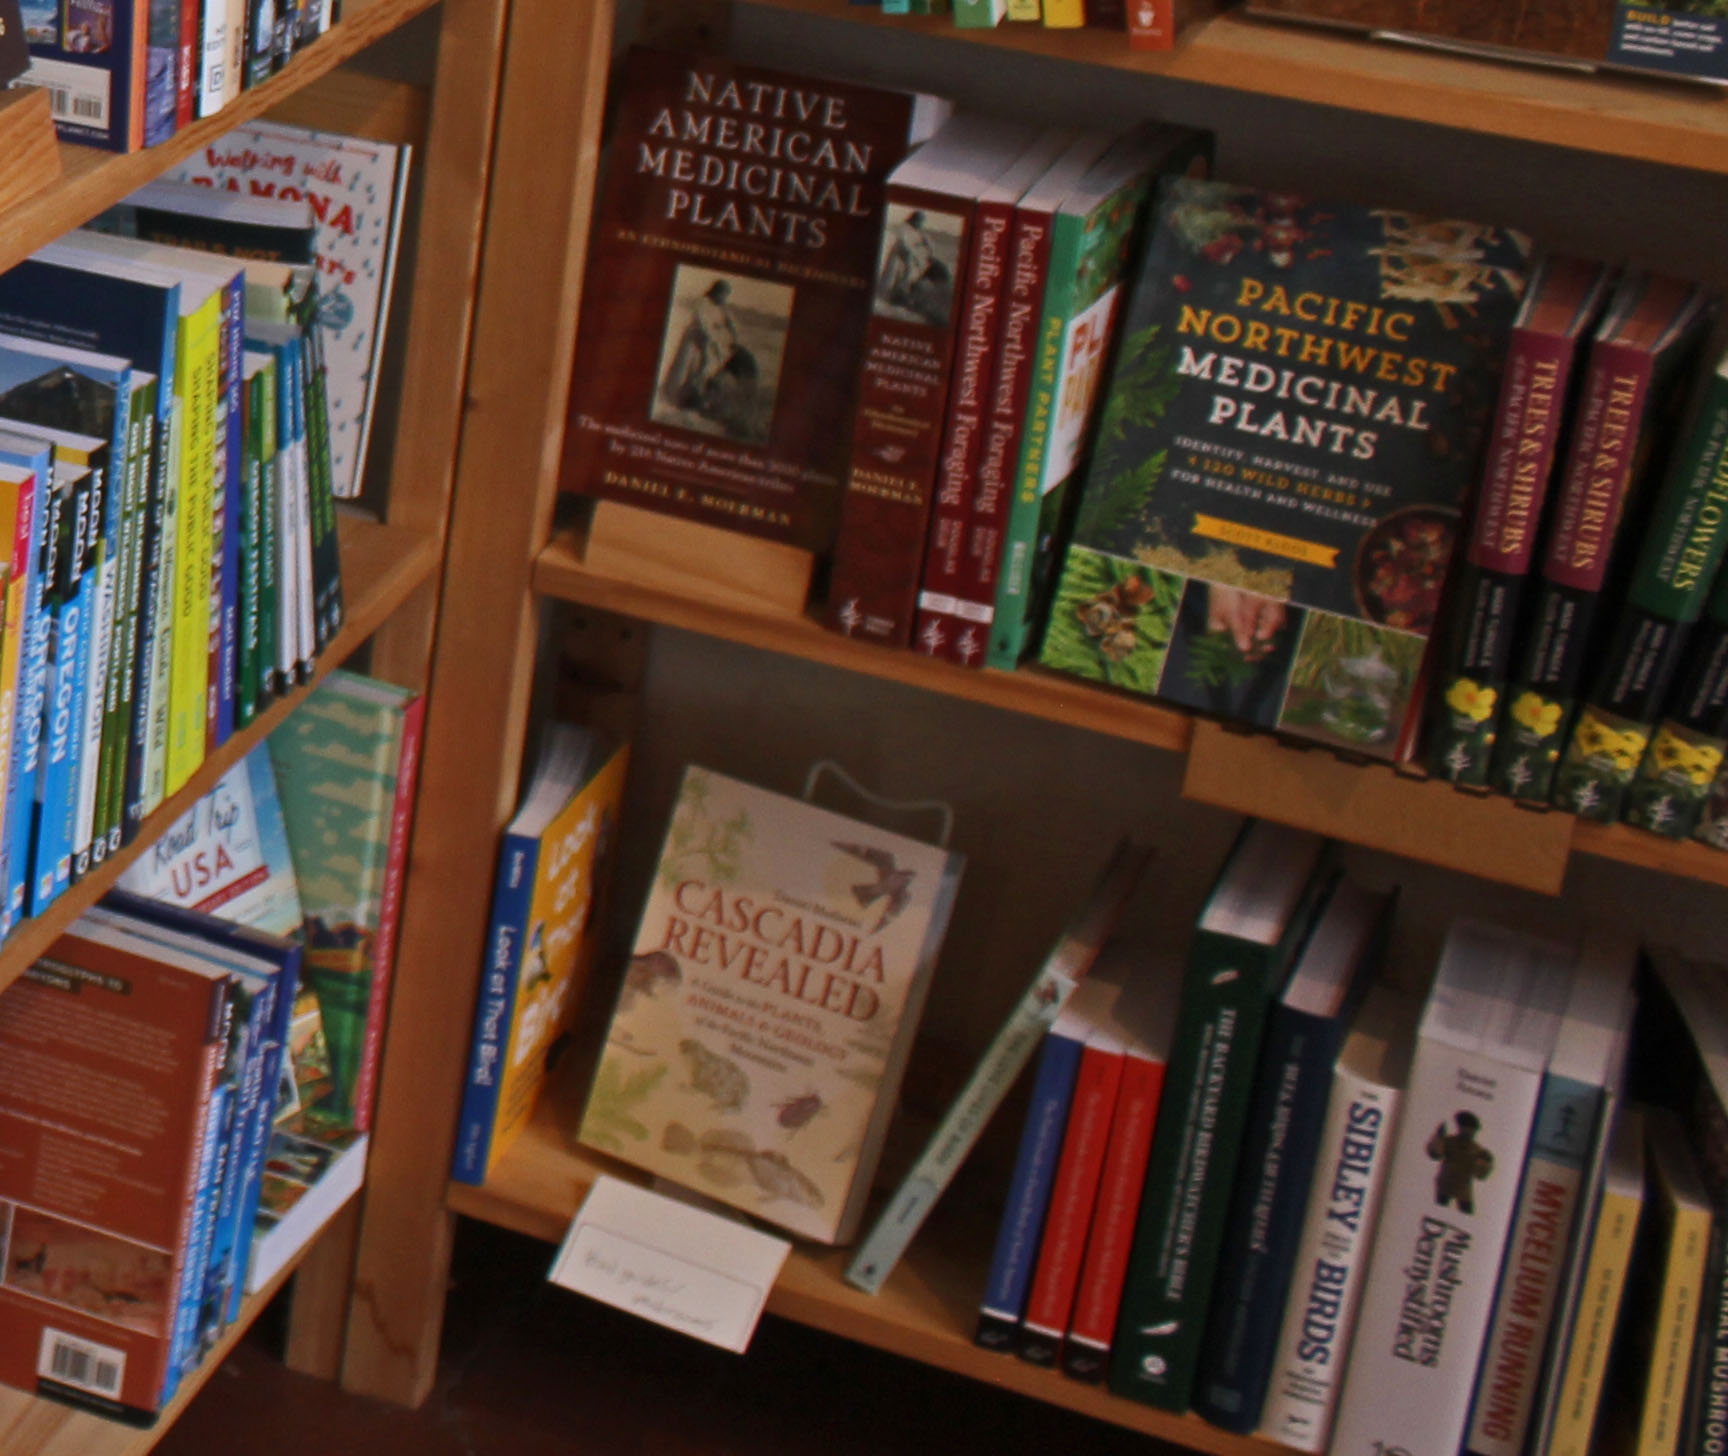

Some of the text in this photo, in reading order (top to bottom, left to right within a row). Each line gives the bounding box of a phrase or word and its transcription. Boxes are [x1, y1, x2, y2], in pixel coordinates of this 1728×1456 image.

[688, 71, 848, 130] NATIVE
[649, 108, 872, 175] AMERICAN
[638, 142, 872, 218] MEDICINAL
[667, 189, 828, 249] PLANTS
[1238, 277, 1415, 341] PACIFIC
[1177, 305, 1457, 392] NORTHWEST
[1177, 347, 1431, 430] MEDICINAL
[1209, 396, 1379, 459] PLANTS
[170, 844, 234, 899] USA
[674, 880, 885, 983] CASCADIA
[662, 916, 882, 1025] REVEALED
[1298, 1102, 1383, 1365] SIBLEY BIRDS
